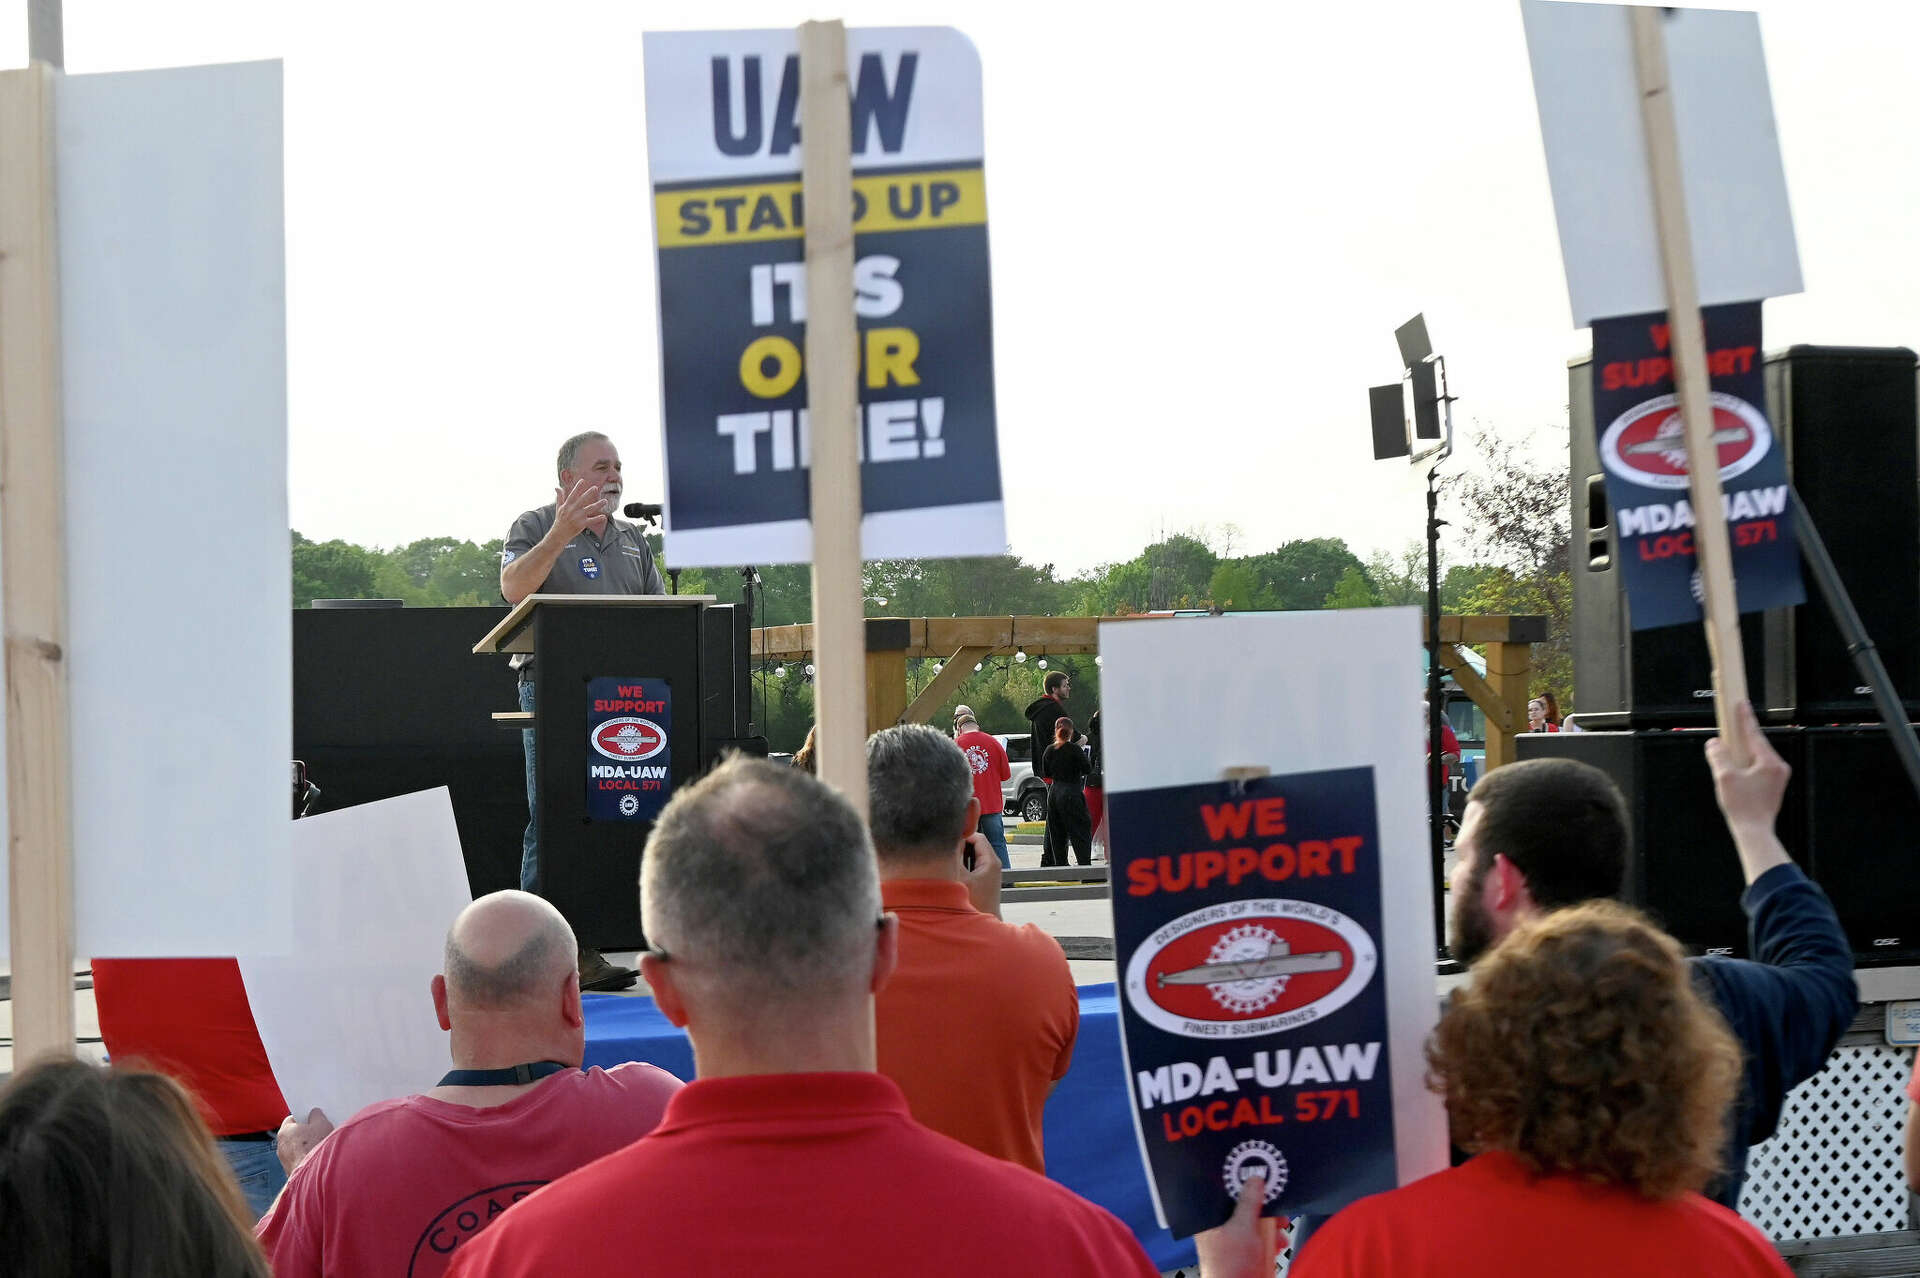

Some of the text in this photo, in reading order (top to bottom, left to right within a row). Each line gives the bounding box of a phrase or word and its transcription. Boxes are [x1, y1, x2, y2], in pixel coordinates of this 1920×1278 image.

[711, 51, 919, 157] UAW
[888, 182, 961, 220] UP
[750, 255, 904, 326] ITS
[739, 327, 921, 398] OR
[1602, 345, 1756, 391] SUPRT
[716, 397, 946, 474] TIE!
[1616, 484, 1789, 538] MDAAW
[1638, 520, 1778, 561] LOC 571
[594, 699, 666, 713] SUPPORT
[617, 685, 643, 698] WE
[591, 765, 667, 778] MDA-UAW
[599, 780, 661, 791] LOCAL 571
[1201, 797, 1287, 841] WE
[1126, 836, 1364, 897] SUPPORT
[1155, 907, 1227, 945] DESIGNERS
[1230, 902, 1249, 914] OF
[1252, 901, 1277, 913] THE
[1183, 1007, 1319, 1035] FINEST SUBMARINES
[1136, 1042, 1382, 1109] MDA-UAW
[1162, 1089, 1360, 1142] LOCAL 571
